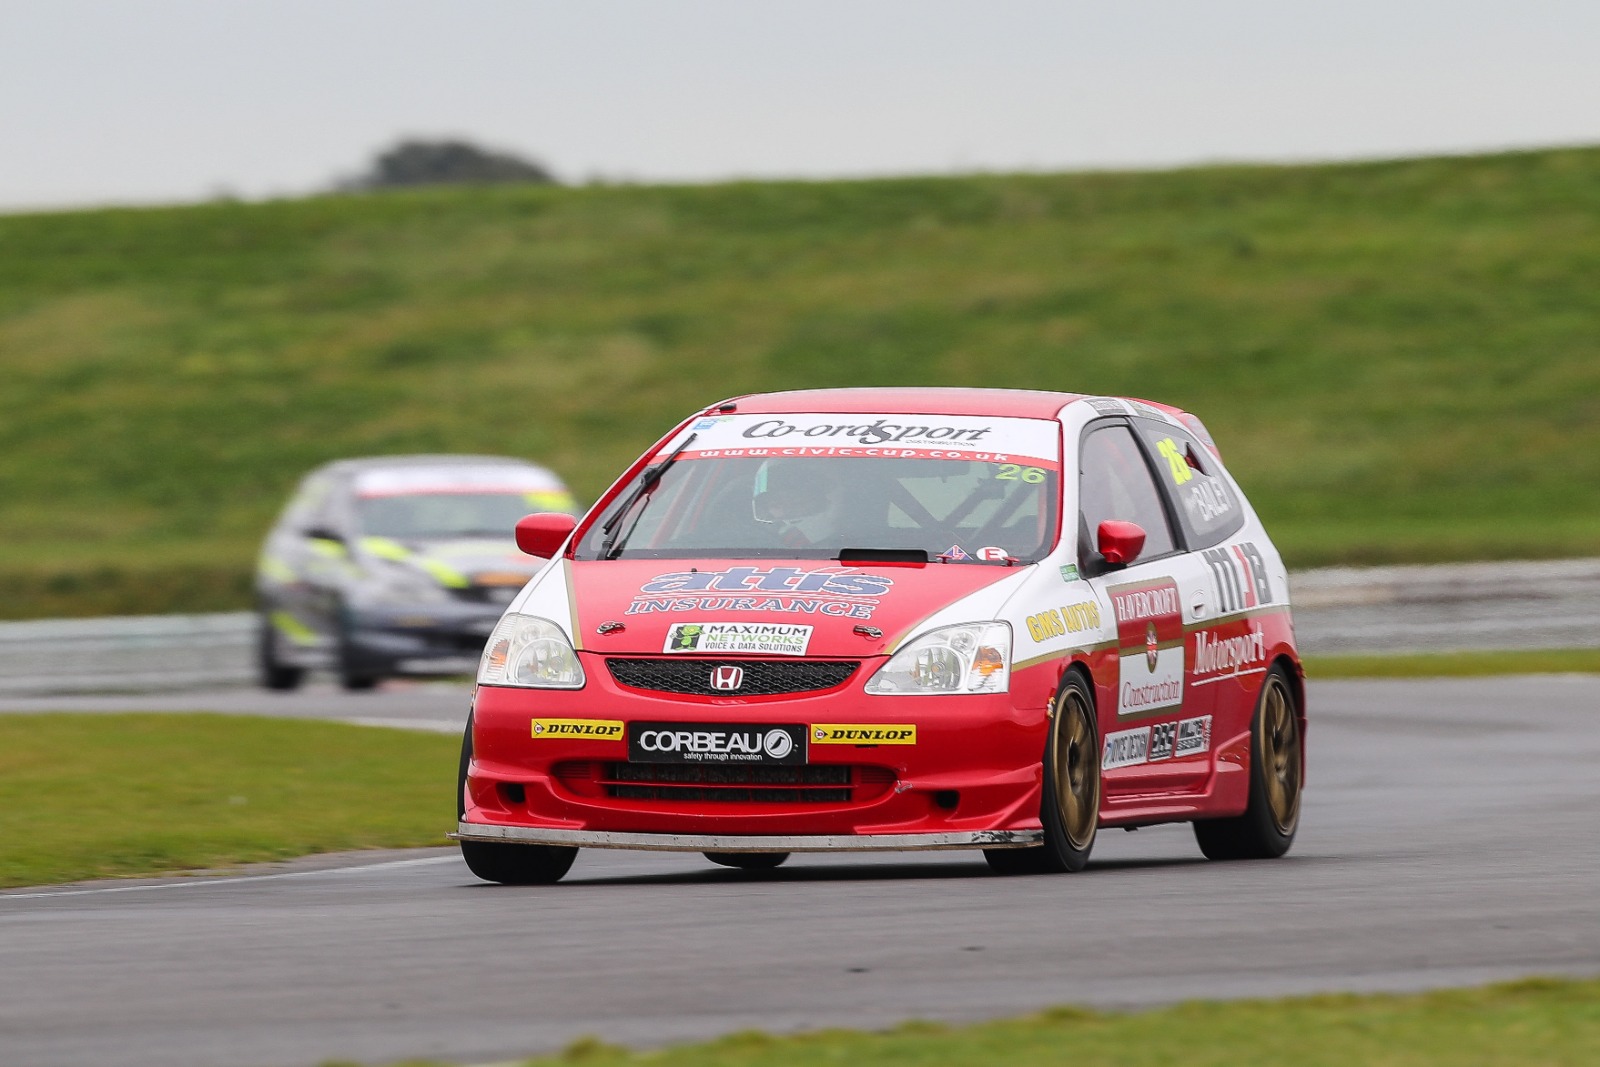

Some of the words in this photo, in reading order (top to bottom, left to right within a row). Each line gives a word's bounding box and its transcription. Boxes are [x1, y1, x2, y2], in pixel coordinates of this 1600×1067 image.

[699, 446, 1008, 462] www.civic-cup.co.uk
[995, 463, 1046, 485] 26
[624, 597, 879, 619] INSURANCE
[1115, 587, 1179, 622] HAVERCROFT
[709, 624, 807, 636] MAXIMUM
[1025, 612, 1066, 643] GMS
[1065, 600, 1101, 635] AUTOS
[704, 641, 726, 650] VOICE
[738, 642, 757, 651] DATA
[759, 643, 802, 652] SOLUTIONS
[706, 633, 804, 645] NETWORKS
[1193, 622, 1266, 675] Motorsport
[1122, 675, 1180, 708] Construction
[547, 724, 621, 735] DUNLOP
[830, 729, 913, 740] DUNLOP
[640, 730, 763, 753] CORBEAU
[683, 752, 703, 761] safety
[704, 752, 729, 761] through
[730, 752, 763, 761] innovation
